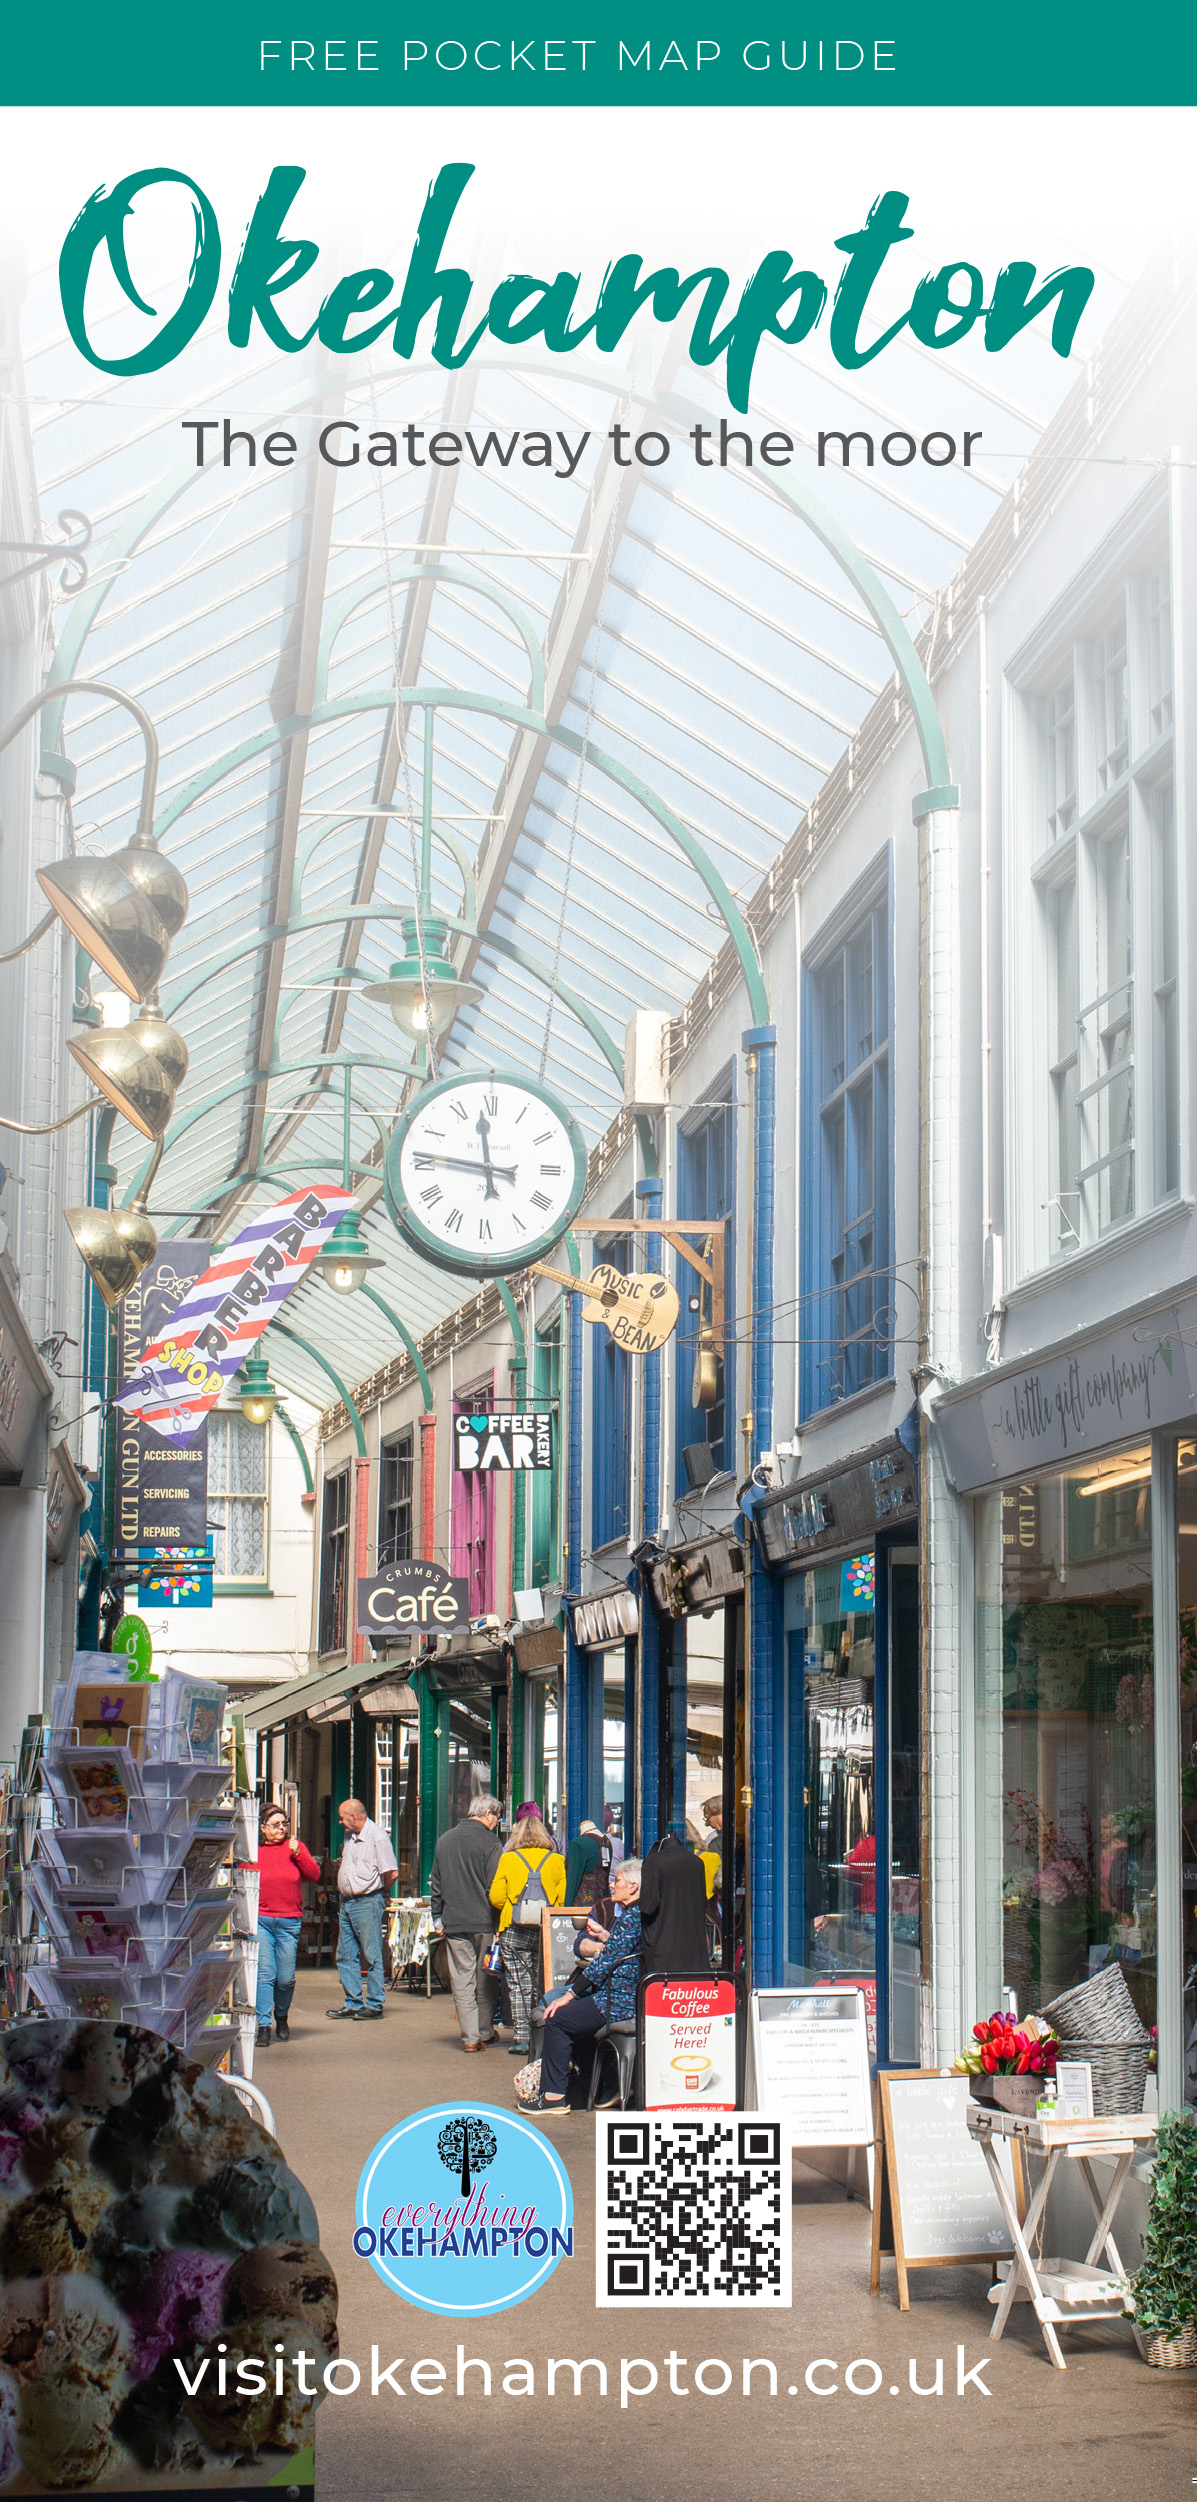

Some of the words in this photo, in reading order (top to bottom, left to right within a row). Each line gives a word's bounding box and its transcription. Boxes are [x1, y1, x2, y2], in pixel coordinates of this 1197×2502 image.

[193, 1192, 328, 1365] BARBER
[601, 1308, 611, 1319] &
[611, 1315, 656, 1350] BEAN
[157, 1341, 225, 1394] SHOP
[1013, 1375, 1052, 1441] little
[1054, 1358, 1085, 1449] gift
[1086, 1354, 1157, 1421] company
[536, 1414, 551, 1468] BAKERY
[143, 1450, 203, 1461] ACCESSORIES
[458, 1434, 535, 1469] BAR
[121, 1438, 140, 1490] GUN
[143, 1488, 190, 1499] SERVICING
[120, 1496, 139, 1541] LTD
[143, 1526, 181, 1537] REPAIRS
[385, 1567, 441, 1583] CRUMBS
[367, 1582, 459, 1623] Café
[662, 1988, 719, 2000] Fabulous
[671, 2001, 710, 2017] Coffee
[670, 2023, 712, 2036] Served
[674, 2037, 707, 2049] Here!
[949, 2232, 986, 2244] Welcome
